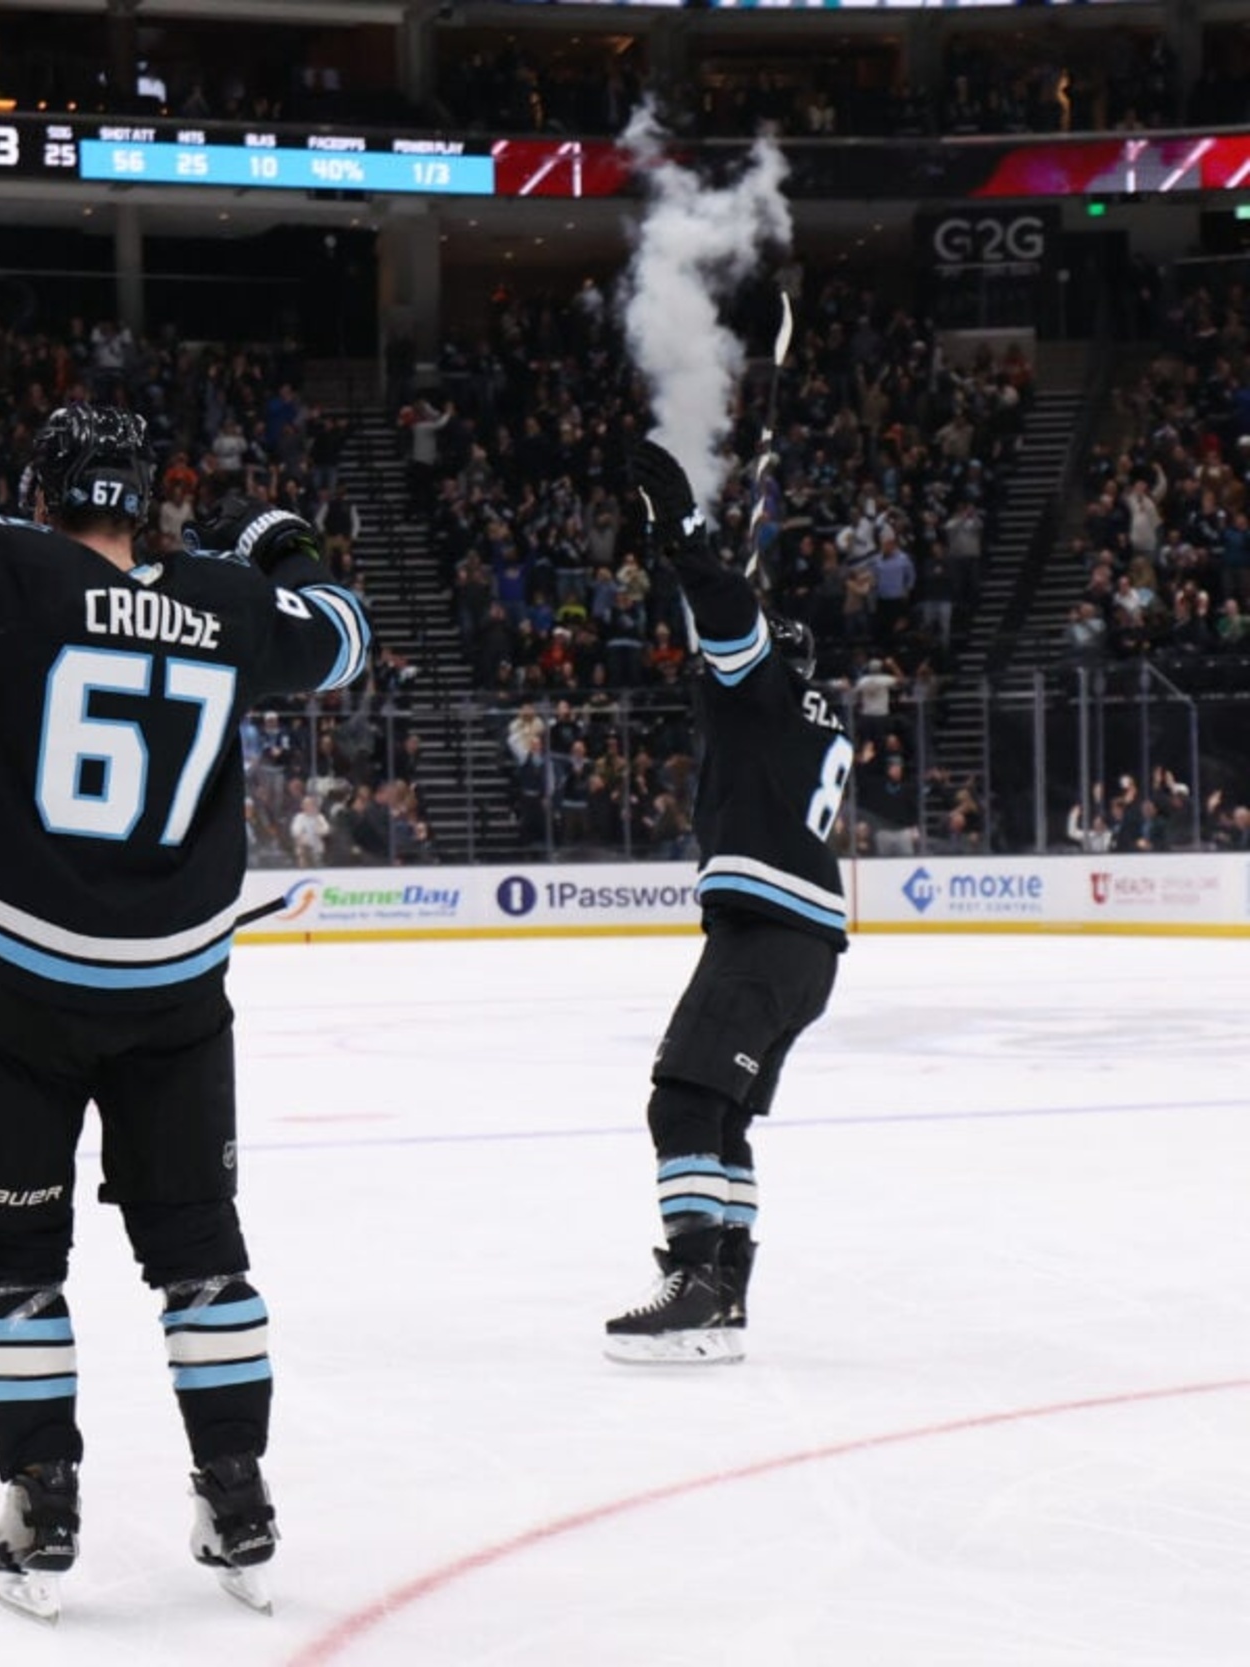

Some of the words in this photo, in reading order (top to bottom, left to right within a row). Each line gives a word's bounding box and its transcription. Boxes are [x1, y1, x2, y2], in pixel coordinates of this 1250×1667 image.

[99, 126, 131, 141] SHOT
[132, 128, 156, 142] ATT
[177, 130, 205, 145] HITS
[44, 144, 76, 166] 25
[434, 141, 465, 156] PLAY
[113, 150, 145, 173] 56
[176, 153, 209, 176] 25
[250, 156, 278, 178] 10
[311, 159, 365, 182] 40%
[413, 163, 451, 185] 1/3
[933, 216, 1045, 261] G2G
[91, 480, 124, 507] 67
[85, 586, 222, 650] CROUSE
[34, 644, 238, 846] 67
[806, 733, 854, 843] 8
[322, 885, 460, 909] SameDay
[949, 875, 1044, 899] moxie
[733, 1051, 760, 1077] CC
